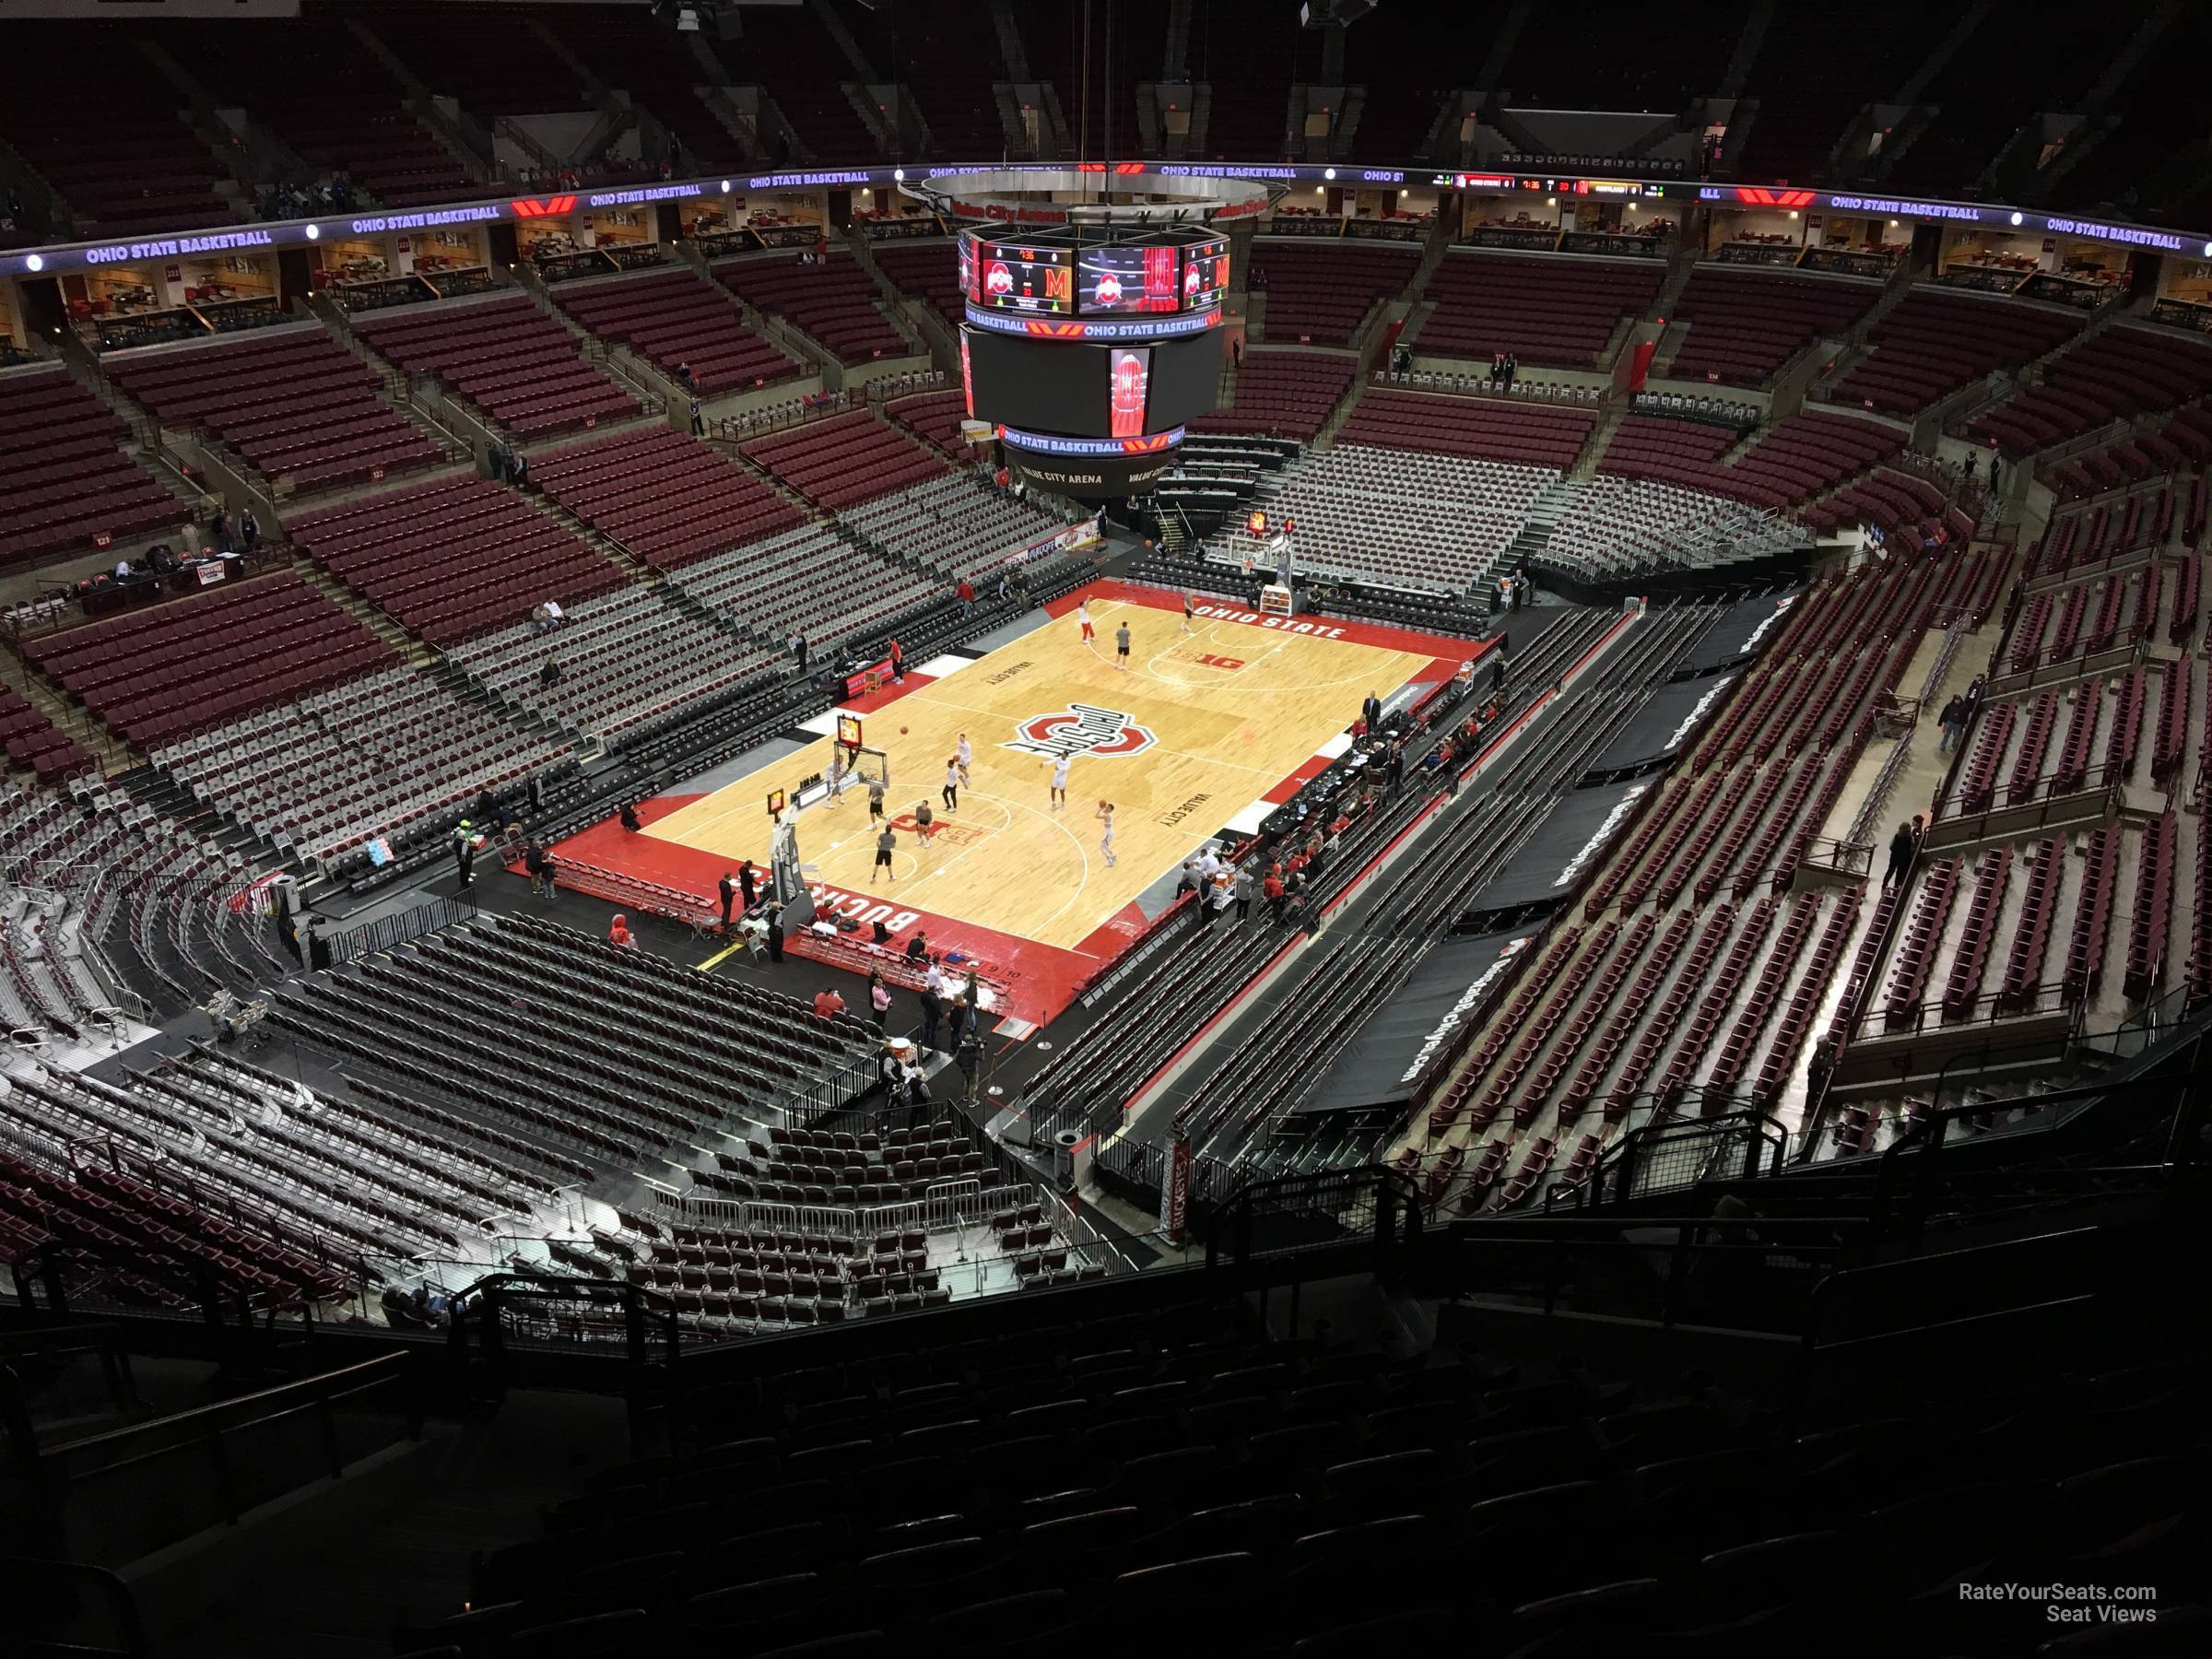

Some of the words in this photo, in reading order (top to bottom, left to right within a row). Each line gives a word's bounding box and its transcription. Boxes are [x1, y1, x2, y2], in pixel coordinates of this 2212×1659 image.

[750, 176, 771, 189] OHIO
[772, 173, 802, 186] STATE
[805, 171, 869, 184] BASKETBALL
[1161, 166, 1190, 176] OHIO
[1191, 167, 1224, 177] STATE
[1227, 168, 1296, 178] BASKETBALL
[1364, 170, 1391, 181] OHIO
[591, 193, 615, 206] OHIO
[618, 190, 644, 204] STATE
[645, 185, 700, 200] BASKETBALL
[1017, 207, 1066, 222] Arena
[1831, 196, 1861, 209] OHIO
[1864, 199, 1899, 213] STATE
[1900, 203, 1979, 220] BASKETBALL
[352, 219, 385, 233] OHIO
[388, 214, 424, 229] STATE
[427, 206, 500, 225] BASKETBALL
[2048, 218, 2074, 231] OHIO
[2076, 222, 2107, 237] STATE
[2109, 228, 2181, 249] BASKETBALL
[87, 249, 128, 264] OHIO
[131, 241, 177, 259] STATE
[180, 230, 272, 253] BASKETBALL
[977, 313, 1029, 331] BASKETBALL
[1084, 325, 1116, 336] OHIO
[1119, 324, 1153, 335] STATE
[1156, 319, 1208, 334] BASKETBALL
[1005, 429, 1020, 444] OHIO
[1021, 437, 1049, 450] STATE
[1051, 441, 1124, 453] BASKETBALL
[1045, 470, 1066, 483] CITY
[1068, 474, 1102, 485] ARENA
[1129, 472, 1151, 484] VALUE
[97, 536, 110, 546] 121
[1193, 606, 1261, 623] OHIO
[1261, 617, 1347, 639] STATE
[1008, 661, 1035, 677] VALUE
[986, 673, 1008, 686] CITY
[1178, 794, 1213, 812] VALUE
[1159, 809, 1186, 828] CITY
[1173, 1161, 1187, 1229] BUCKEYES
